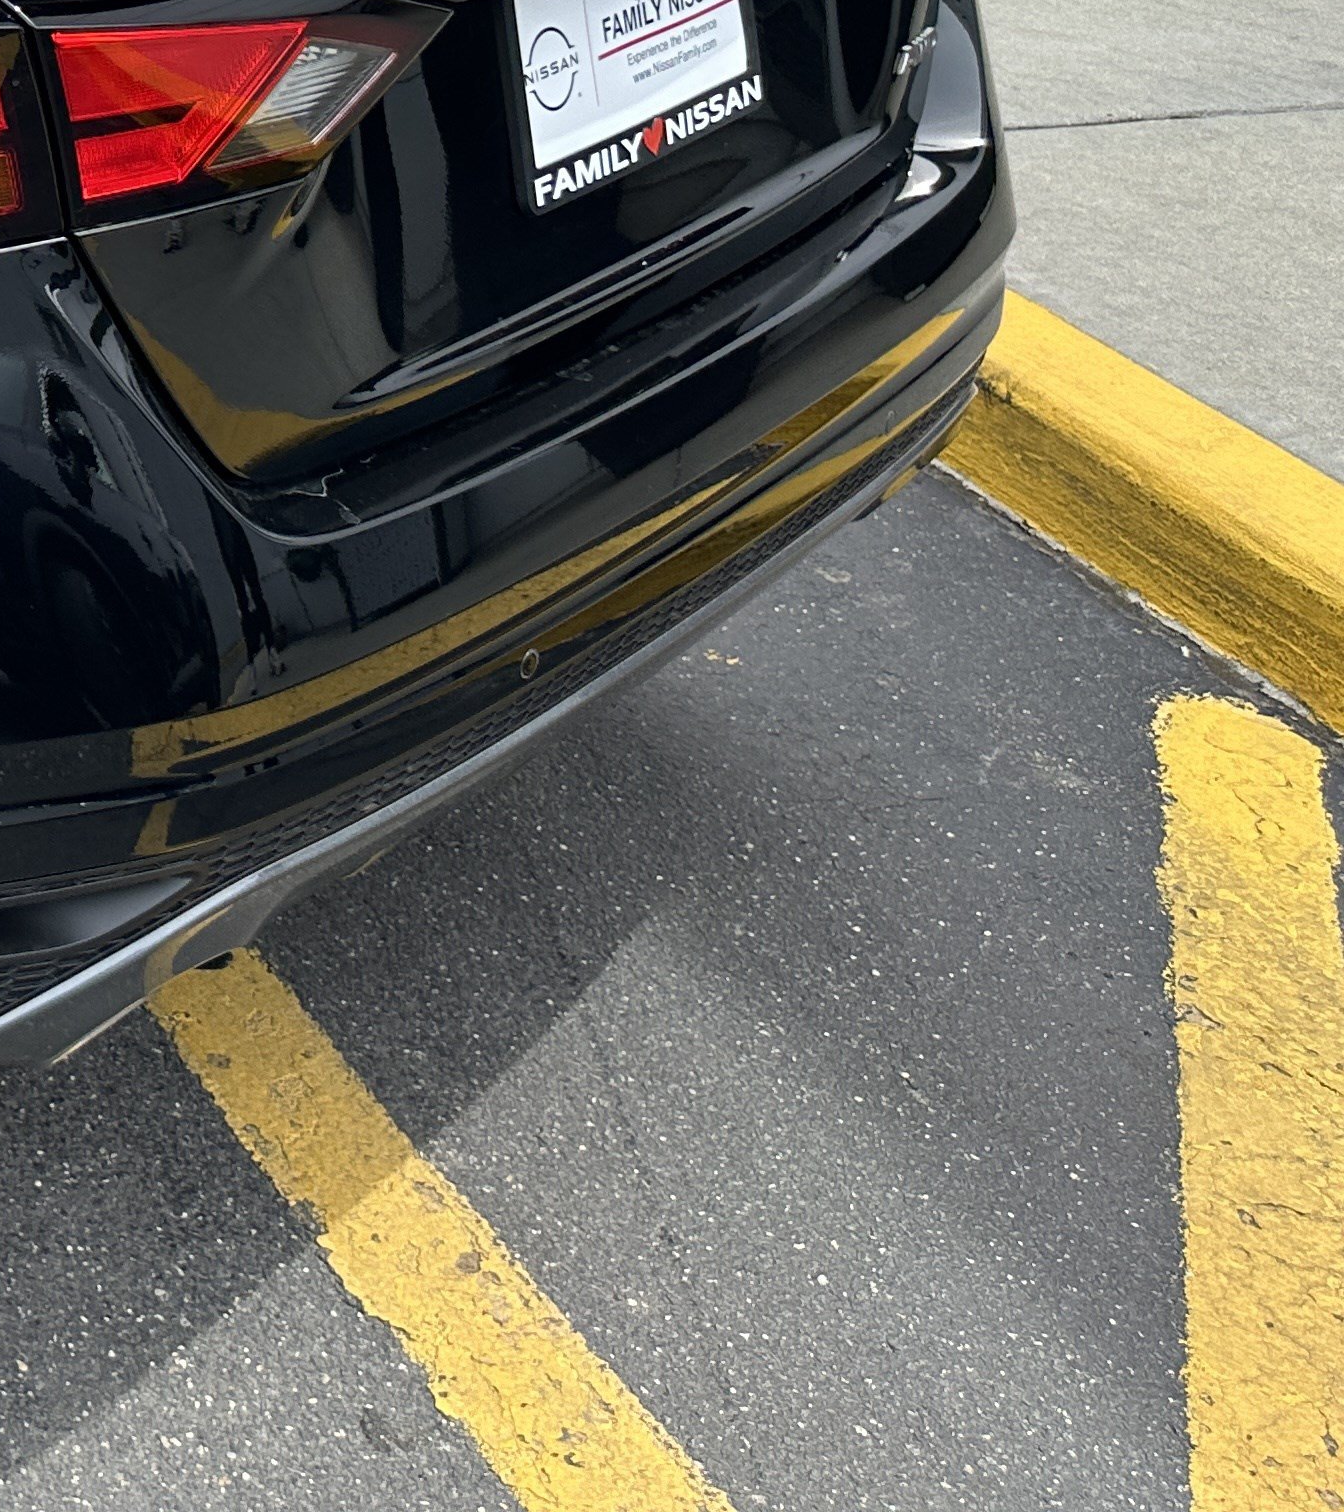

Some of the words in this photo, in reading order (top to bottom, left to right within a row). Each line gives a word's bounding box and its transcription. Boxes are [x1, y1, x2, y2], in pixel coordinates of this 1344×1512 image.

[627, 38, 669, 66] Experience
[682, 18, 718, 42] Difference
[632, 37, 718, 85] www.NissanFamily.com
[523, 51, 580, 87] NISSAN
[533, 131, 644, 208] FAMILY
[664, 74, 763, 145] NISSAN
